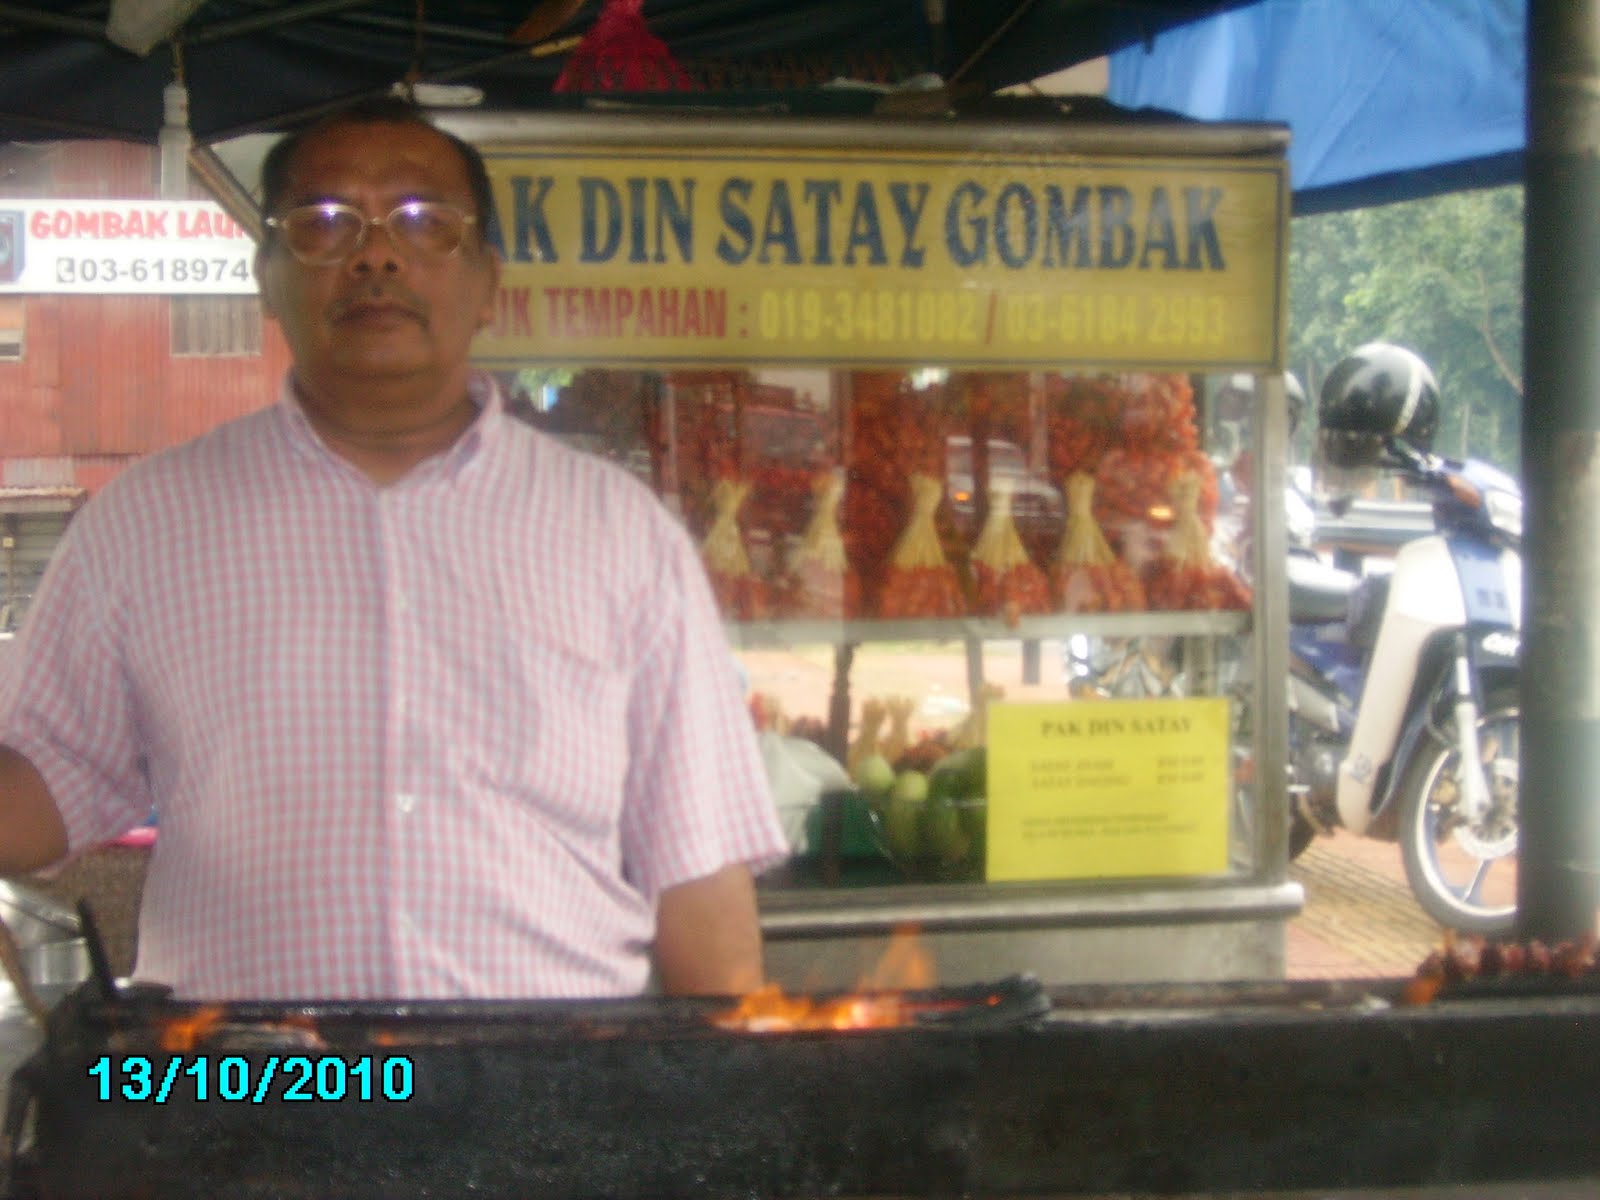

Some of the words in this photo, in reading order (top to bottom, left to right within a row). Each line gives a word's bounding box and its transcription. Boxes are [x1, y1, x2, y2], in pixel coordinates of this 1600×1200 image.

[31, 210, 167, 239] GOMBAK
[578, 177, 696, 264] DIN
[715, 177, 930, 268] SATAY
[944, 181, 1227, 271] GOMBAK
[80, 258, 249, 282] 03-618974
[544, 287, 727, 337] TEMPAHAN
[1041, 719, 1081, 737] PAK
[1089, 718, 1125, 736] DIN
[1131, 716, 1192, 735] SATAY
